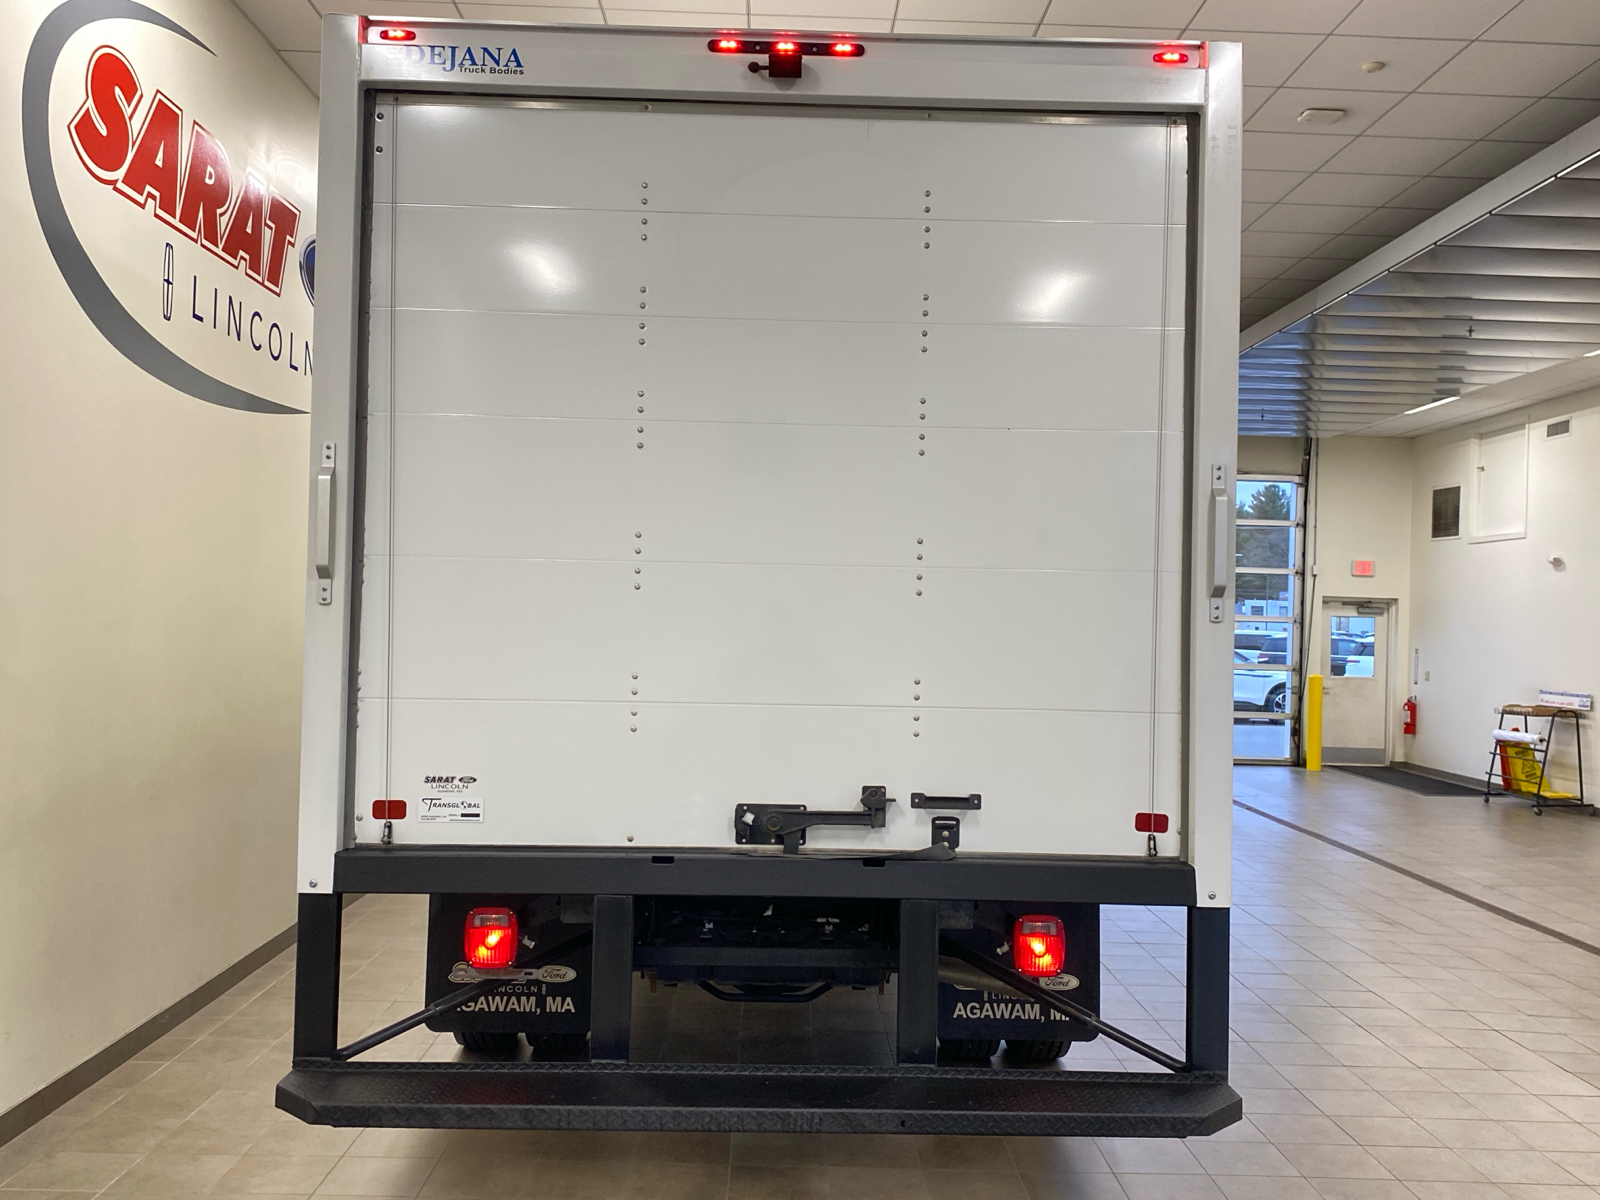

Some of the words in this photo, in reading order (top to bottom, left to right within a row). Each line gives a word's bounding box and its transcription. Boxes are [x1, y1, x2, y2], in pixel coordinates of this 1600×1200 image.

[405, 44, 524, 72] DEJANA
[459, 66, 486, 74] Truck
[489, 67, 525, 75] Bodies
[68, 45, 300, 297] SARAT
[541, 968, 569, 981] Ford
[1044, 976, 1071, 987] Ford
[456, 996, 540, 1015] GAWAM,
[546, 997, 576, 1013] MA
[953, 1002, 1045, 1022] AGAWAM,
[1050, 1008, 1070, 1021] M
